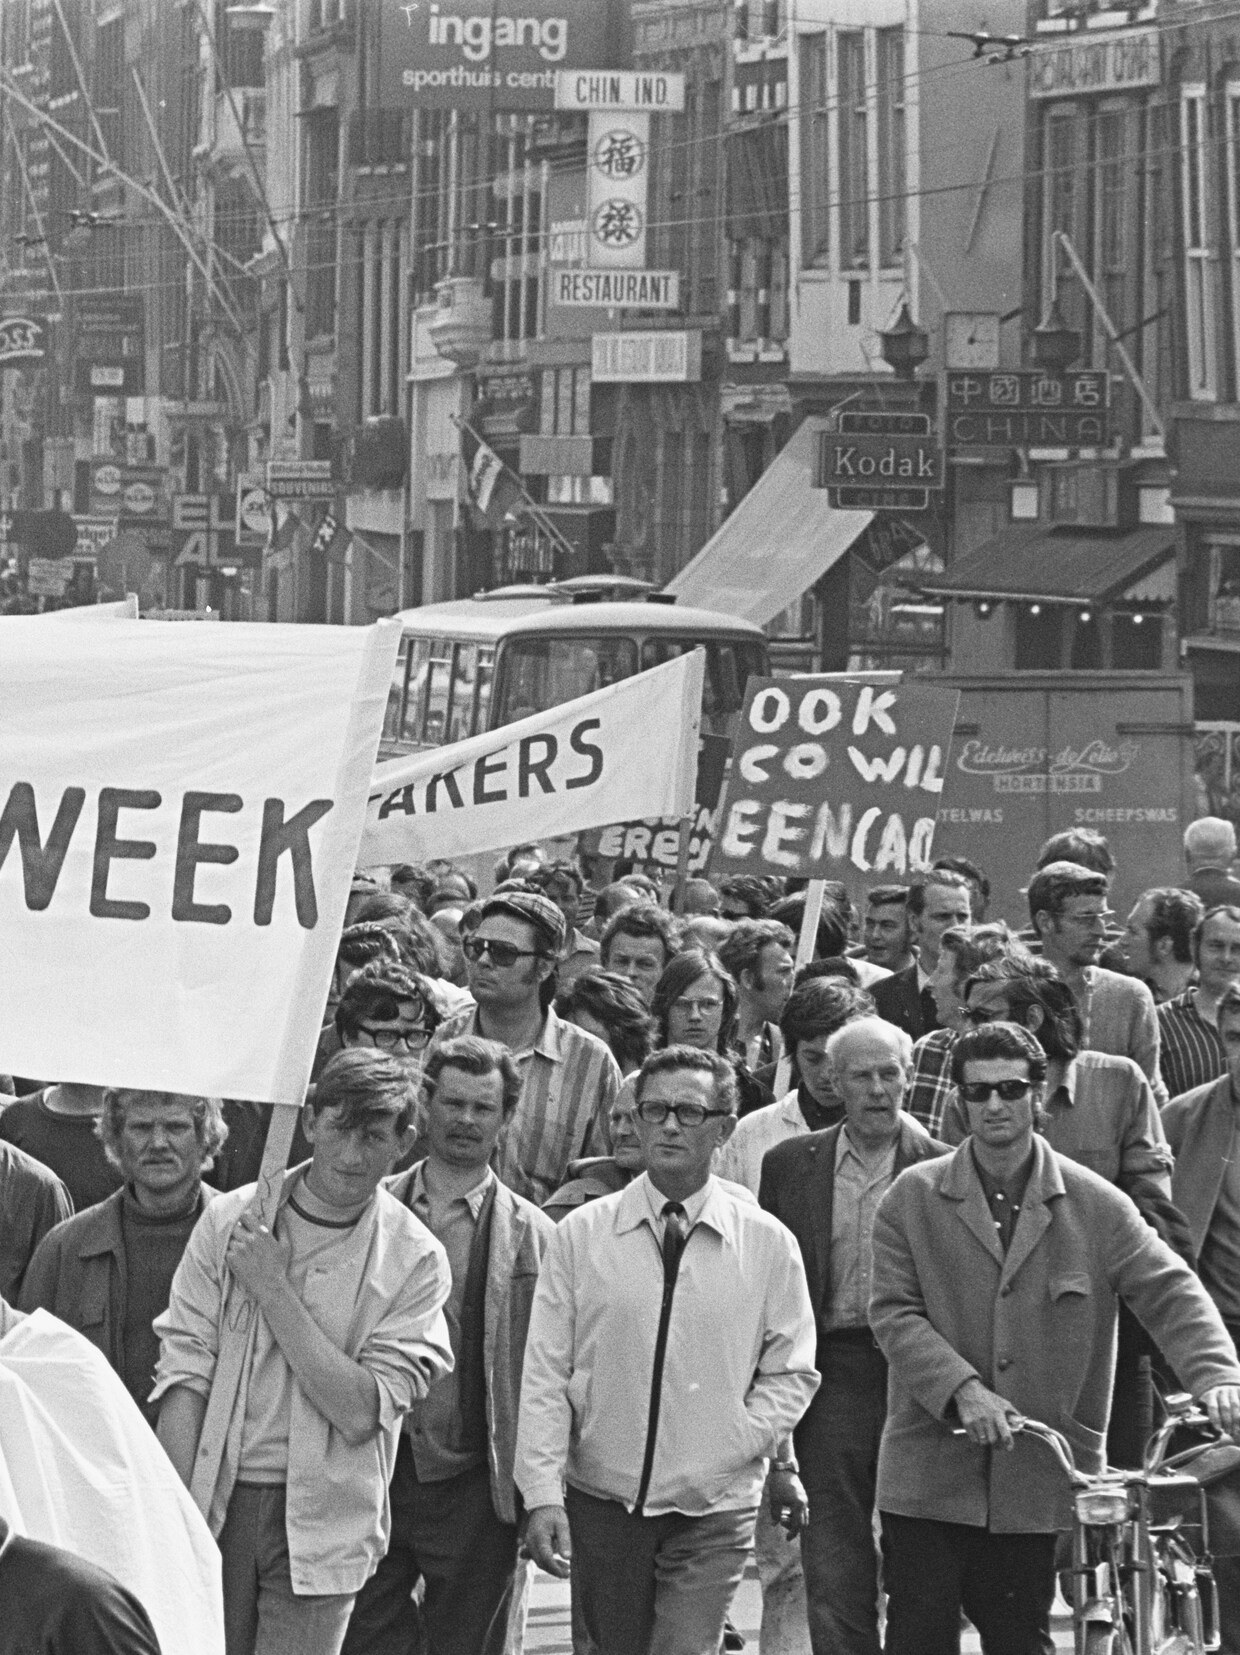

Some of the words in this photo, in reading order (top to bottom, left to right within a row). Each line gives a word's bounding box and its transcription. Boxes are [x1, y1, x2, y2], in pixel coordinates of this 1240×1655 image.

[429, 4, 567, 61] ingang
[403, 65, 501, 91] sporthuis
[507, 69, 566, 88] cent
[561, 274, 670, 301] RESTAURANT
[953, 416, 1102, 441] CHINA
[835, 447, 934, 477] Kodak
[173, 495, 237, 529] EL
[174, 531, 243, 566] AL
[749, 686, 897, 735] OOK
[368, 718, 603, 820] AKERS
[740, 742, 830, 782] CO
[847, 744, 944, 792] WIL
[936, 807, 1004, 823] TELWAS
[1074, 807, 1177, 822] SCHEEPSWAS
